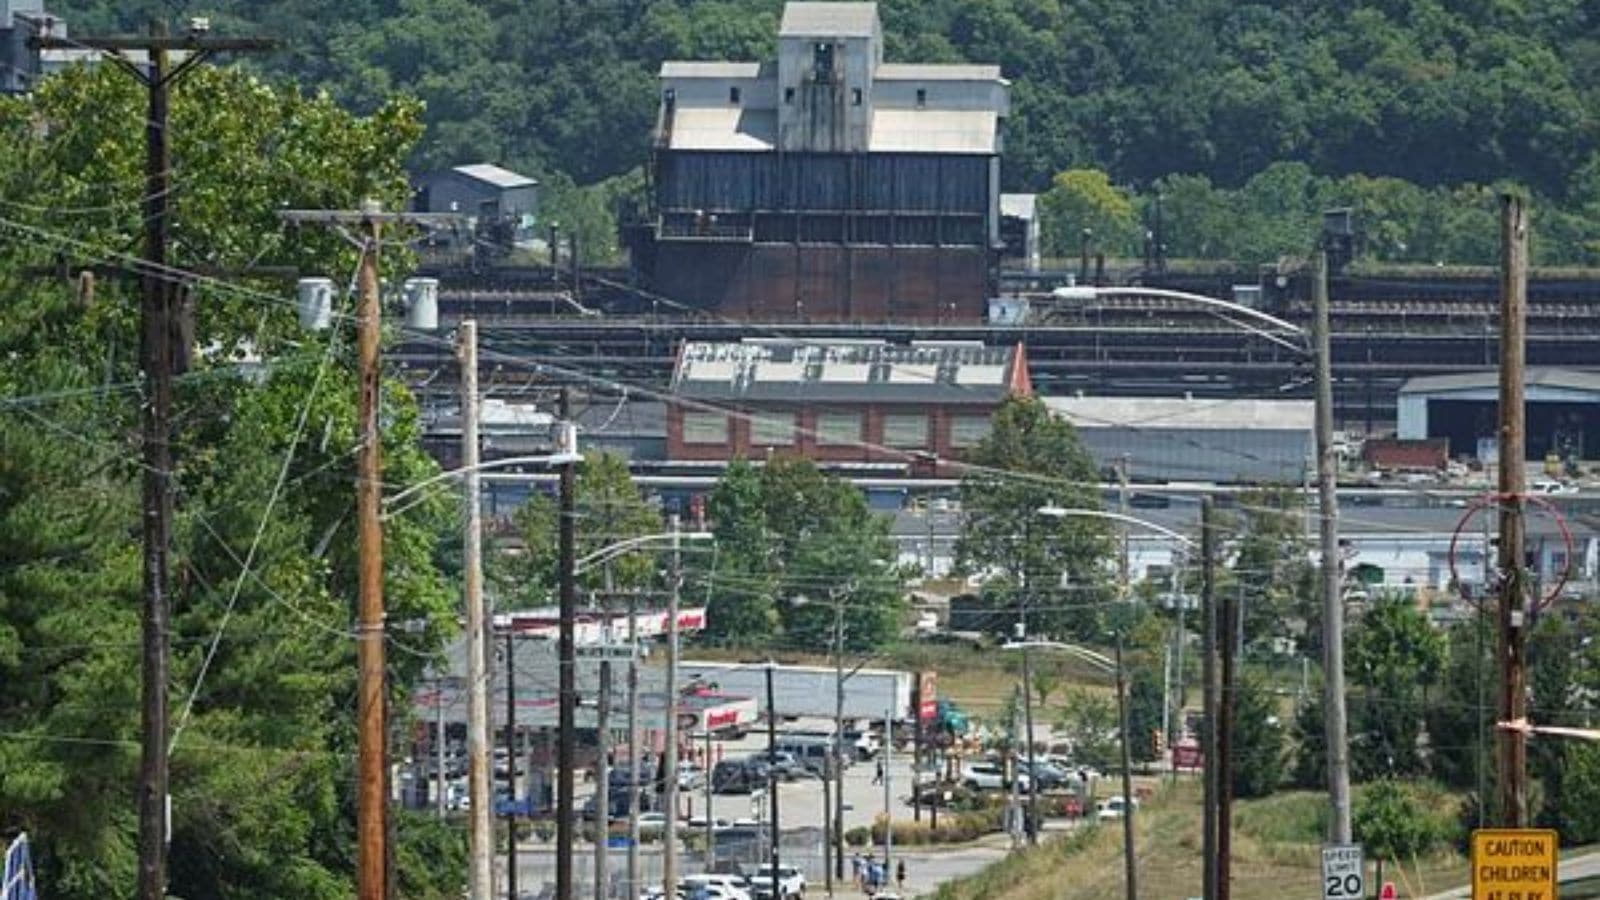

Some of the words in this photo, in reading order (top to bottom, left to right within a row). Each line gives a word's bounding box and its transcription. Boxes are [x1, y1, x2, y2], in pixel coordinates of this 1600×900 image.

[1485, 840, 1545, 856] CAUTION
[1480, 866, 1550, 882] CHILDREN
[1327, 874, 1361, 896] 20
